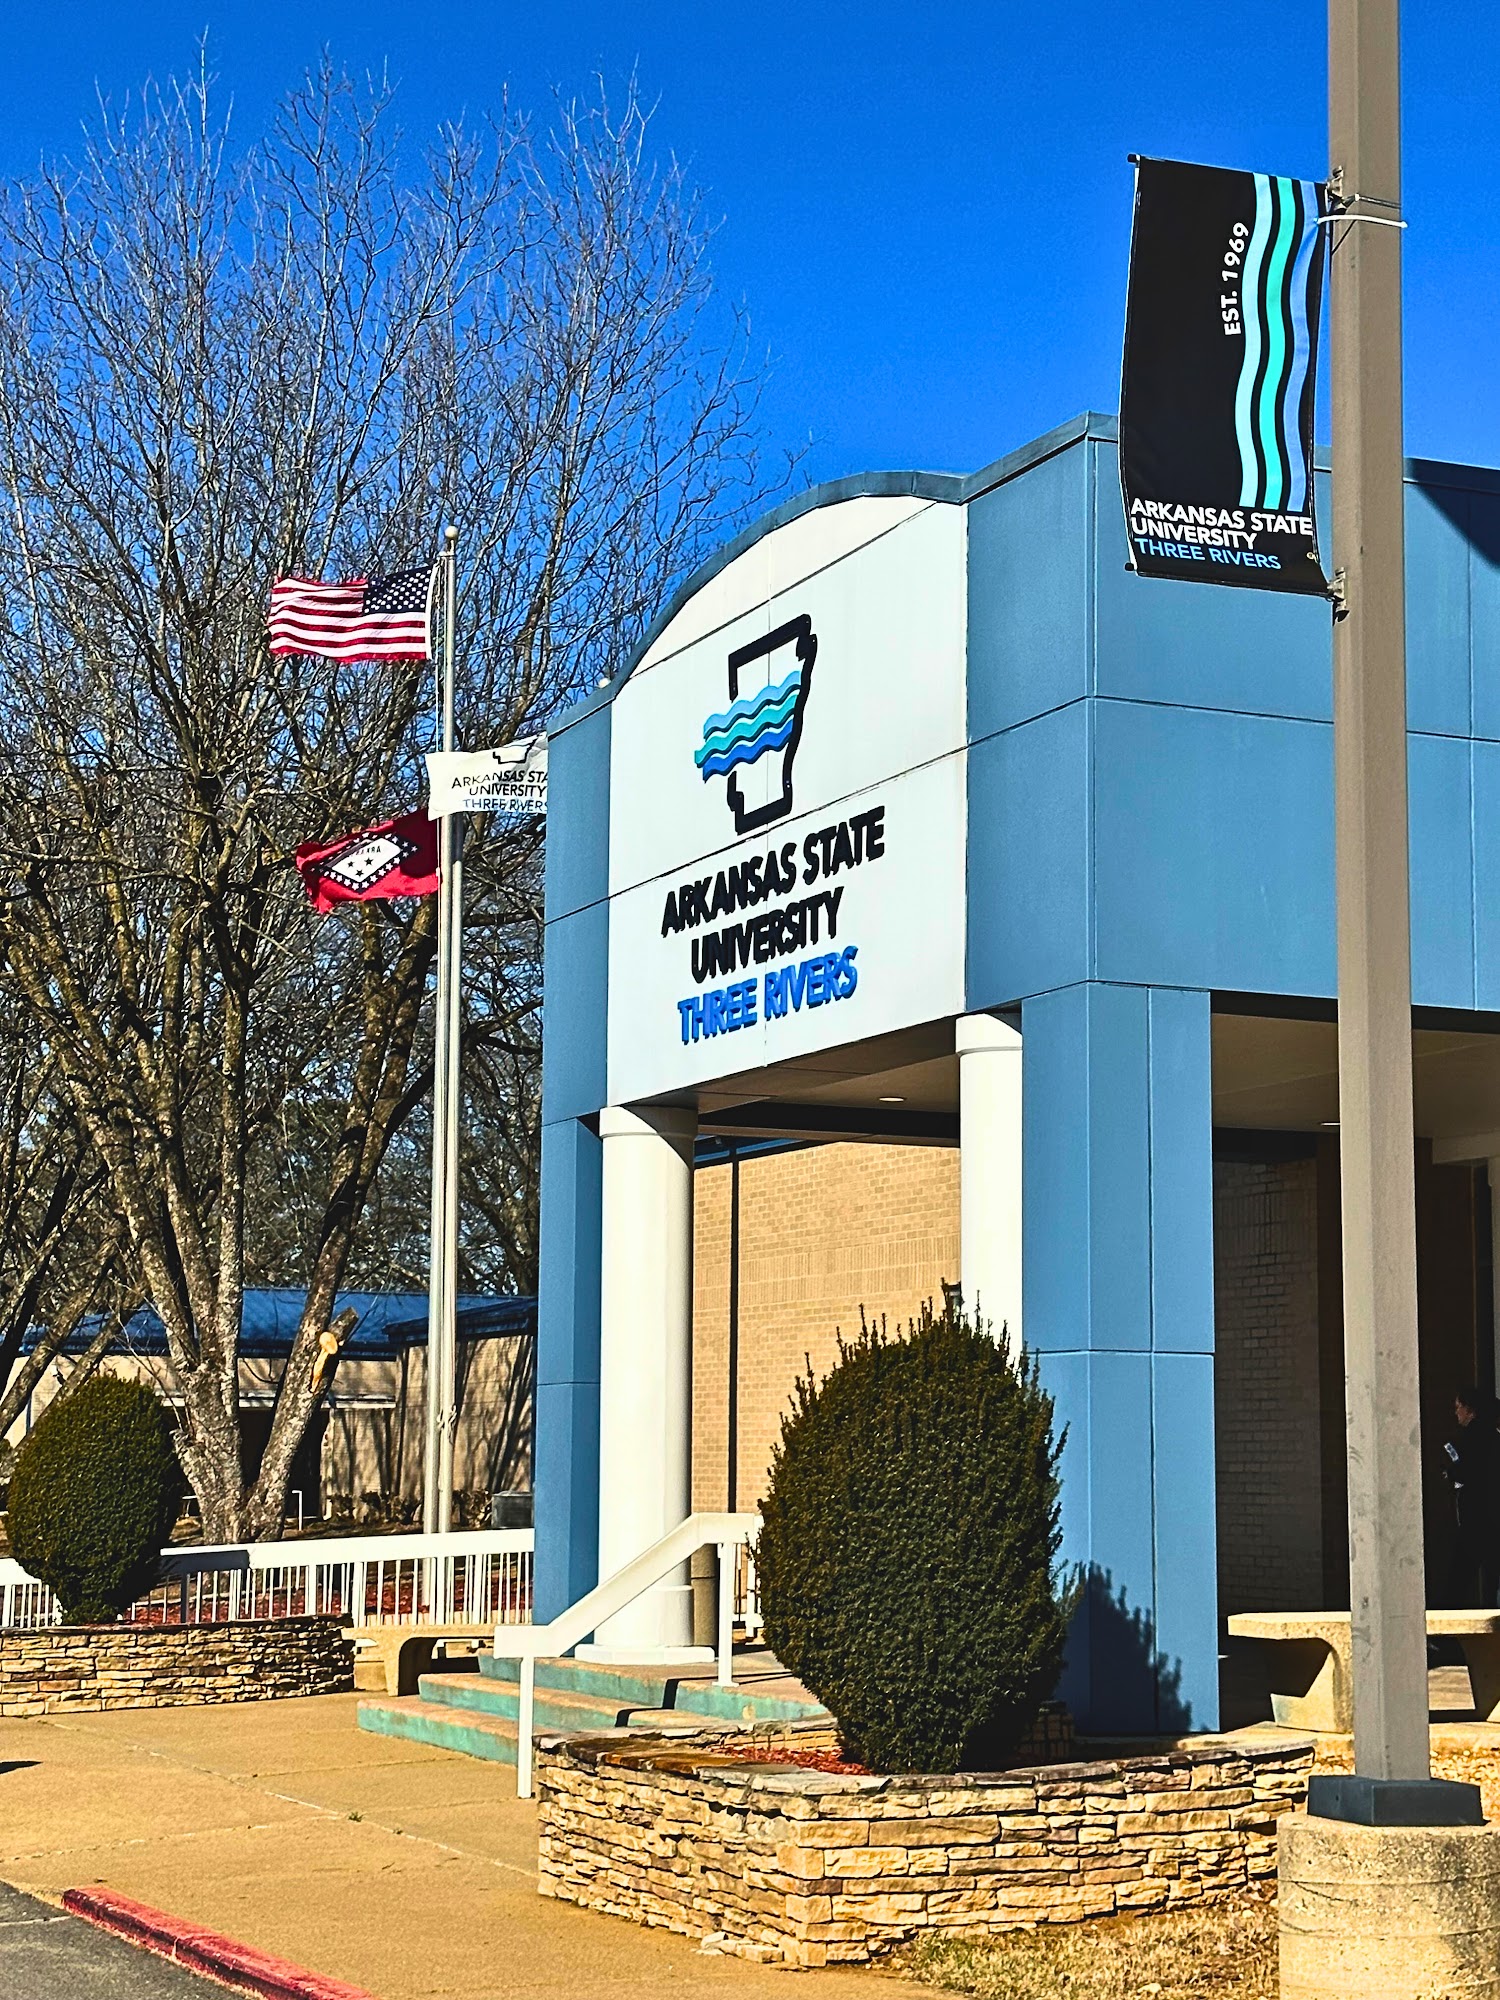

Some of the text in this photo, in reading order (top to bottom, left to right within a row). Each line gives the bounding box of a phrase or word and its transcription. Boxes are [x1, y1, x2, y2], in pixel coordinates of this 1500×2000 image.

[1220, 221, 1250, 336] EST. 1969
[1130, 497, 1314, 537] ARKANSAS STATE
[1131, 516, 1258, 550] UNIVERSITY
[1134, 537, 1282, 570] THREE RIVERS
[451, 770, 526, 790] ARKANSAS
[469, 782, 548, 798] UNIVERSITY
[661, 805, 885, 938] ARKANSAS STATE
[691, 886, 845, 984] UNIVERSITY
[677, 945, 859, 1046] THREE RIVERS
